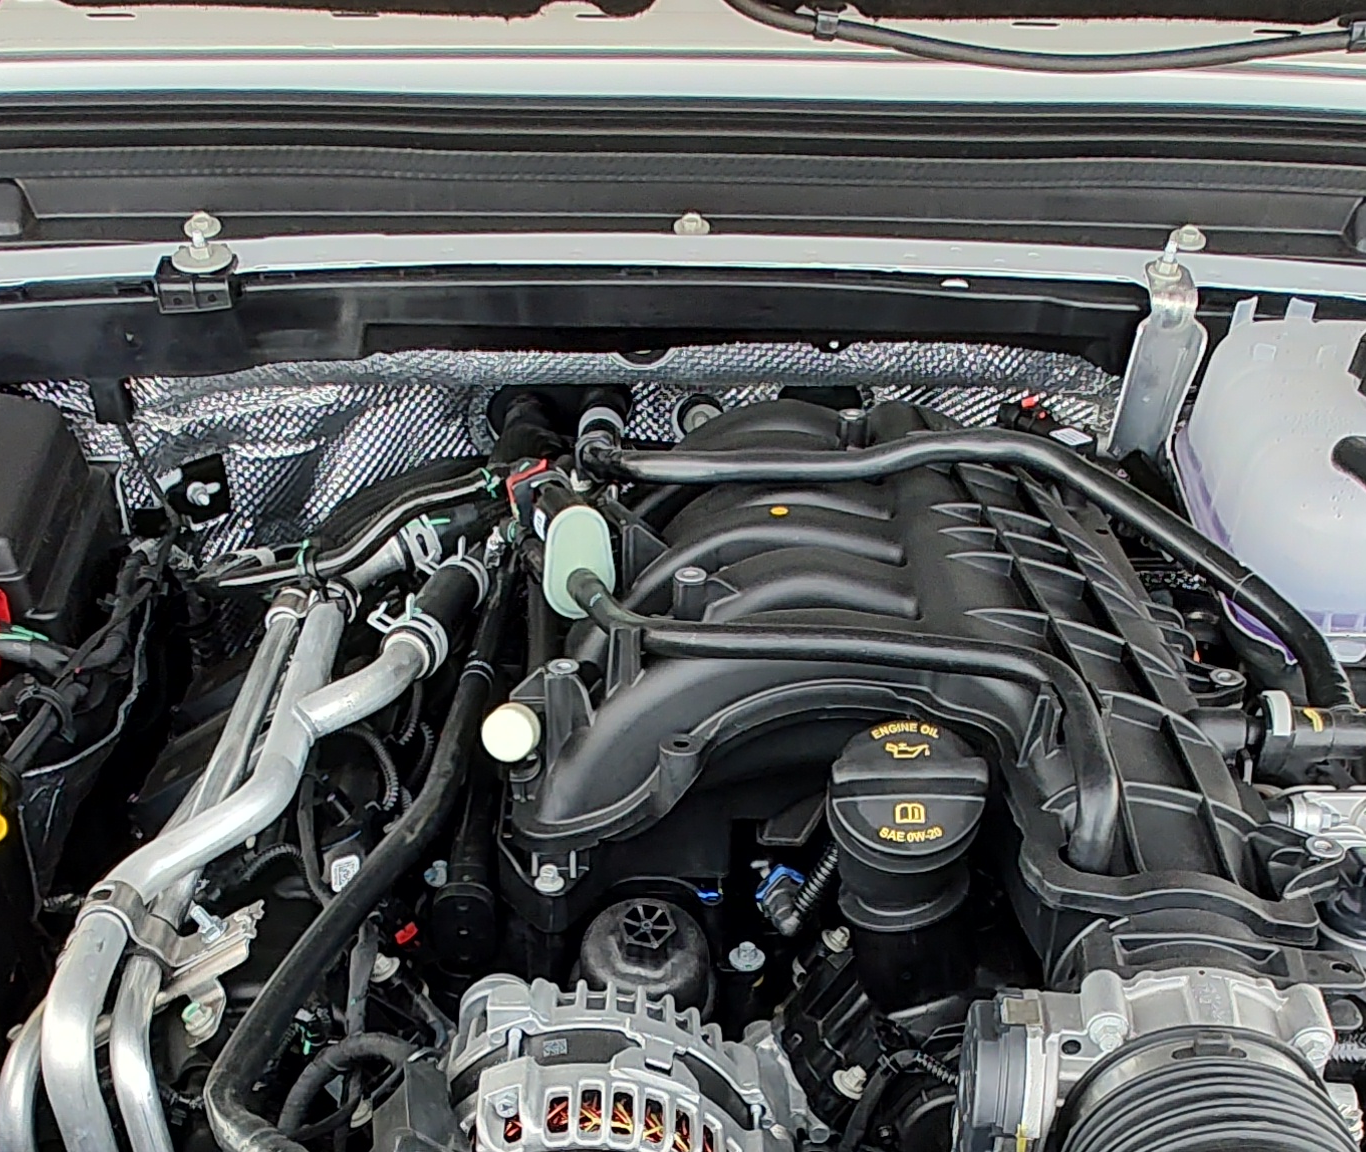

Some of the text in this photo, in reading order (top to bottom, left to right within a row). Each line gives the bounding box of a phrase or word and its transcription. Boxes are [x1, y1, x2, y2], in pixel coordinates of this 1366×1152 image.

[871, 722, 939, 740] ENGINE OIL
[879, 826, 943, 843] SAE 0W-20
